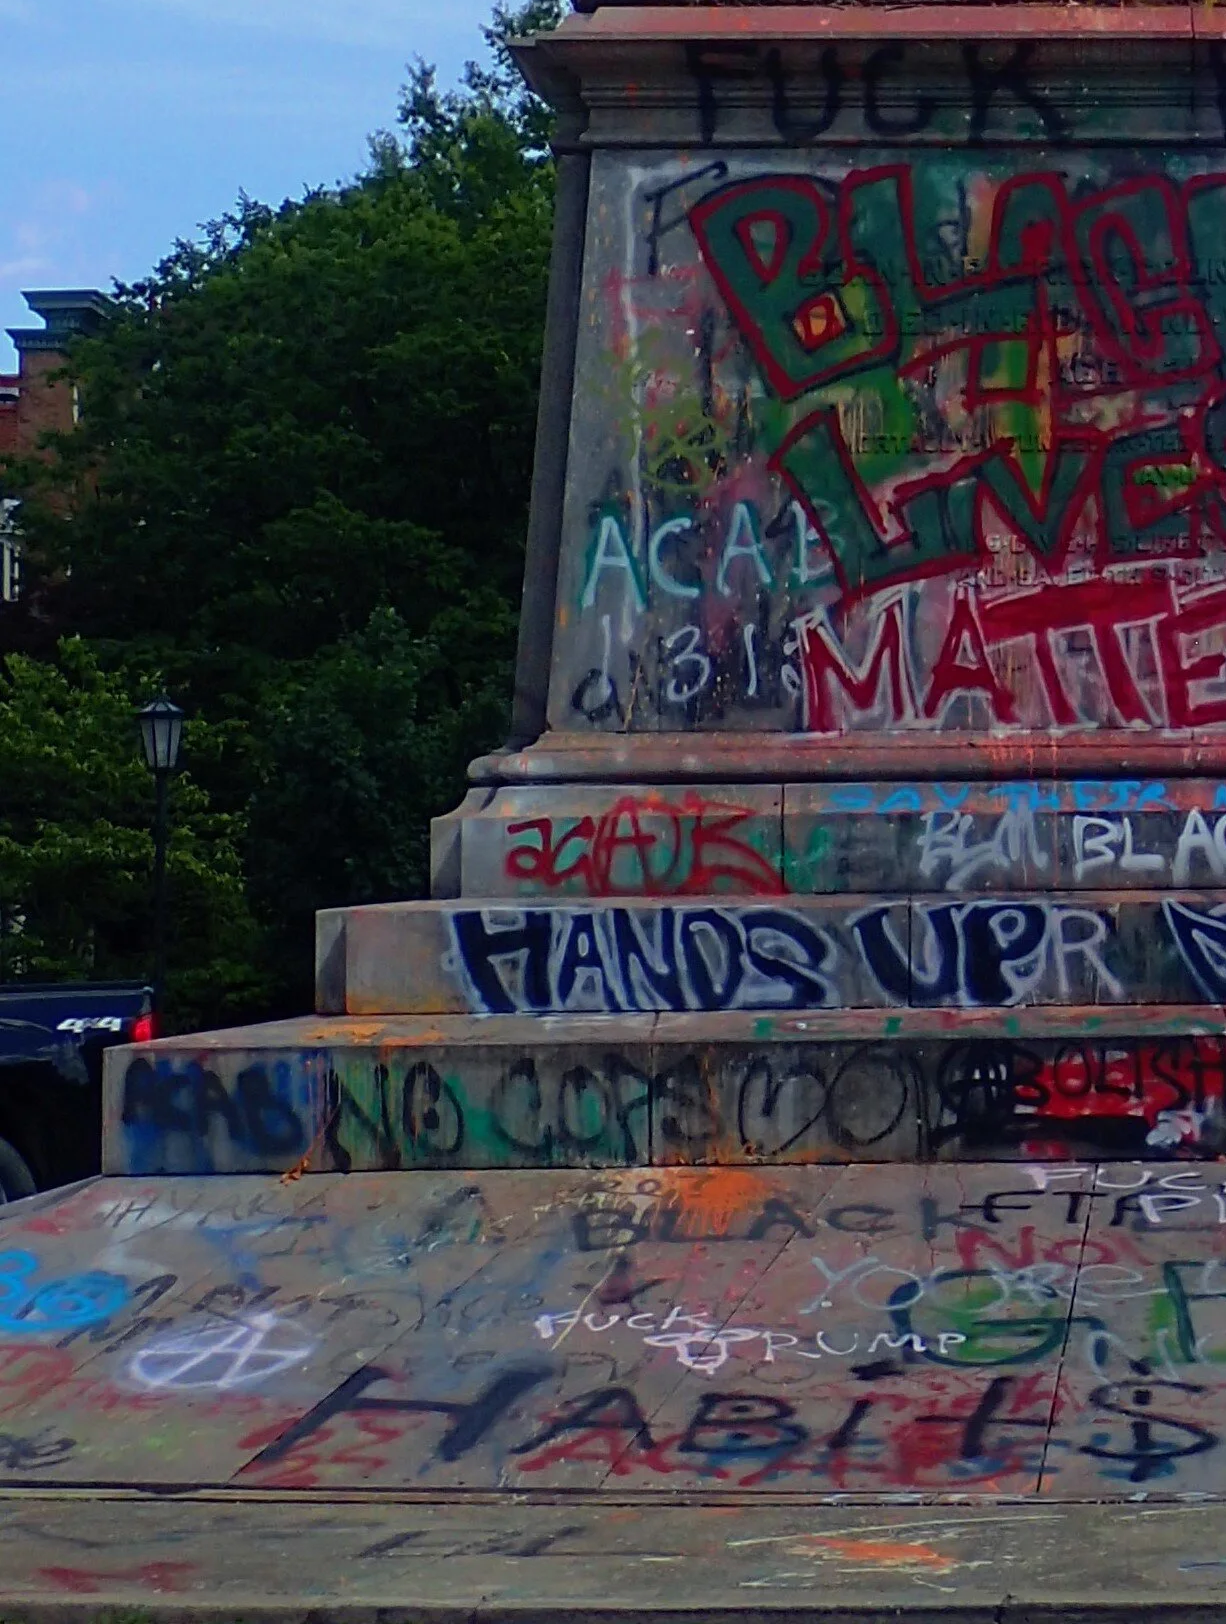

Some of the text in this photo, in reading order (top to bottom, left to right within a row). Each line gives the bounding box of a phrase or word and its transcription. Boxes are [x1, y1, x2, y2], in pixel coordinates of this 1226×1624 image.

[683, 41, 1080, 146] FUCK
[578, 498, 846, 616] ACAB
[830, 789, 972, 813] SAY
[992, 780, 1174, 813] THEIR
[445, 908, 838, 1012] HANDS
[55, 1017, 121, 1034] 4x4
[536, 1300, 716, 1340] FUCK
